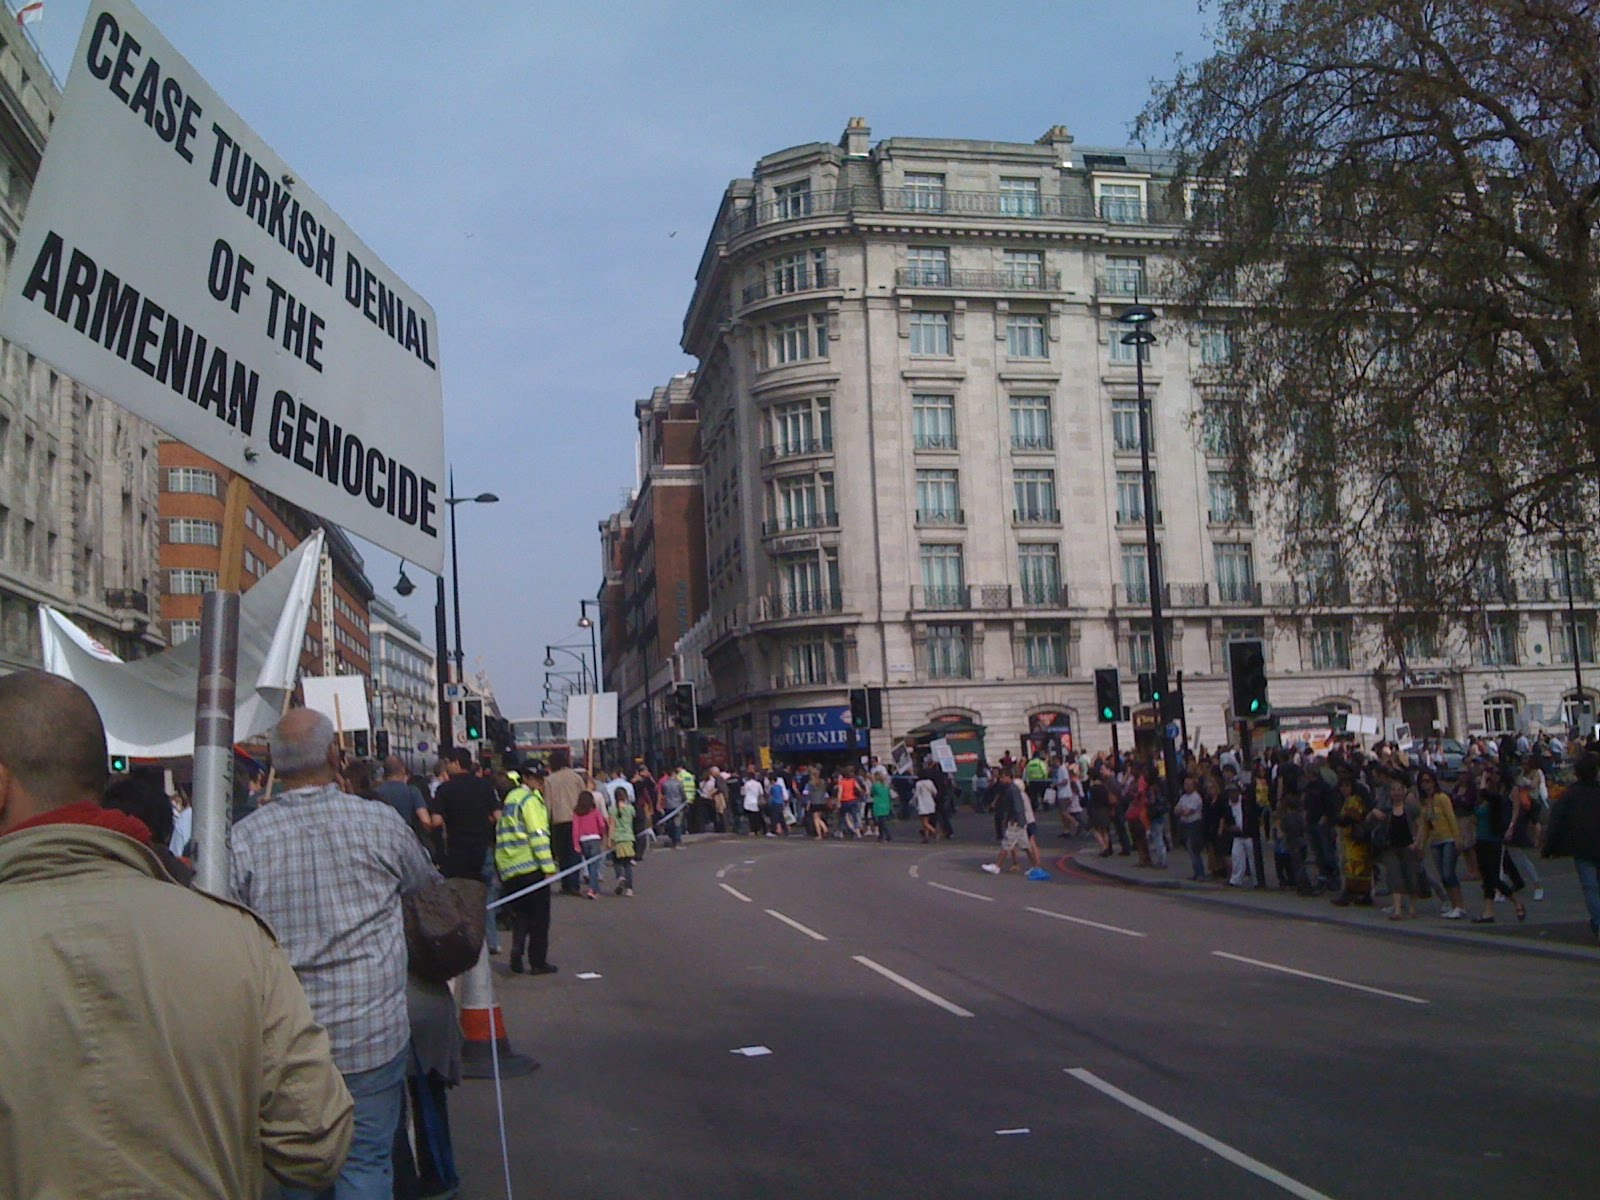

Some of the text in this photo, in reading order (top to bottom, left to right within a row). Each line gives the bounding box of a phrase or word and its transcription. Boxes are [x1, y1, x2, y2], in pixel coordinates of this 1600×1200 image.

[86, 11, 437, 370] CEASE TURKISH DENIAL
[22, 230, 437, 538] ARMENIAN GENOCIDE
[208, 238, 325, 373] OF THE
[789, 712, 827, 727] CITY
